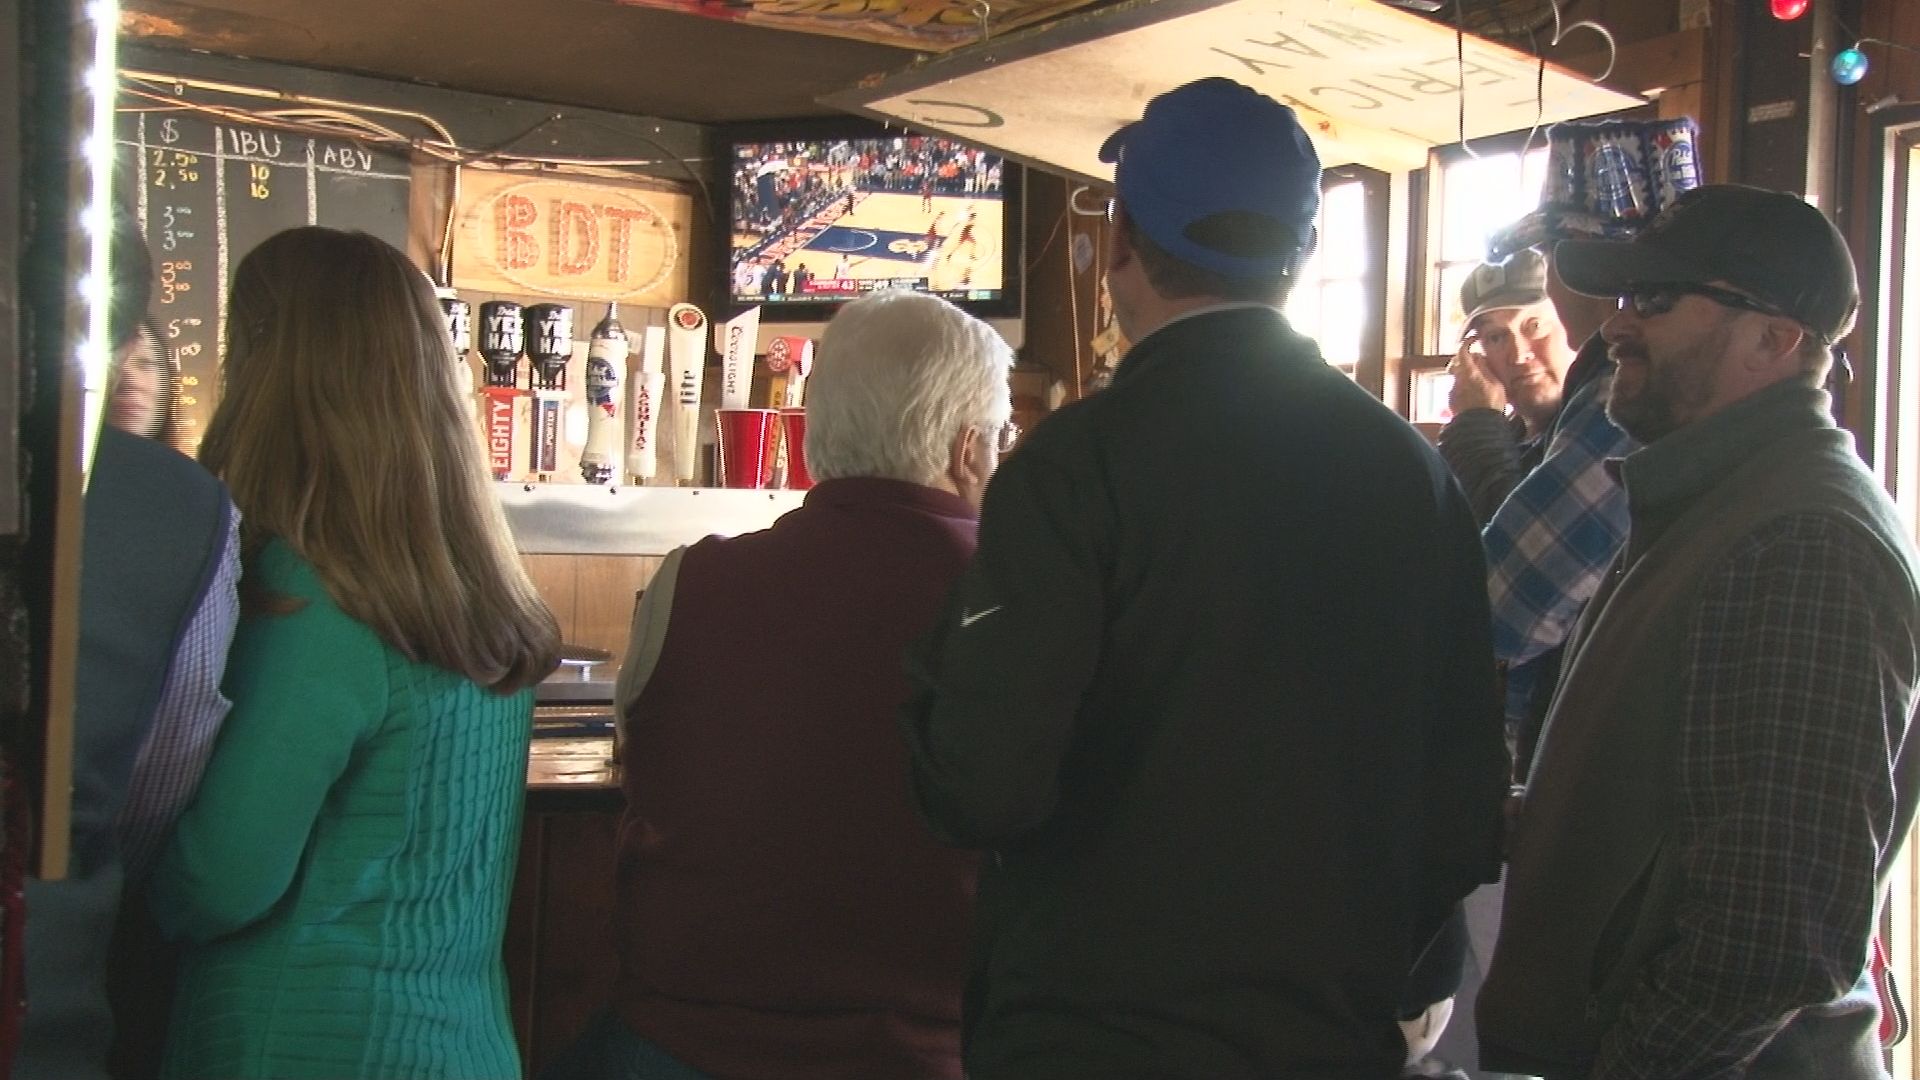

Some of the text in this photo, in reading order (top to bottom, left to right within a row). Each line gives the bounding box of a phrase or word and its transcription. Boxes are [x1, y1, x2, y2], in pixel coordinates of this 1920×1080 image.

[1209, 19, 1403, 75] WAY
[160, 118, 372, 171] $ IBU ABV
[250, 163, 270, 181] 10
[494, 193, 654, 283] BDT
[491, 400, 511, 468] EIGHTY
[636, 384, 650, 450] LAGUNITAS
